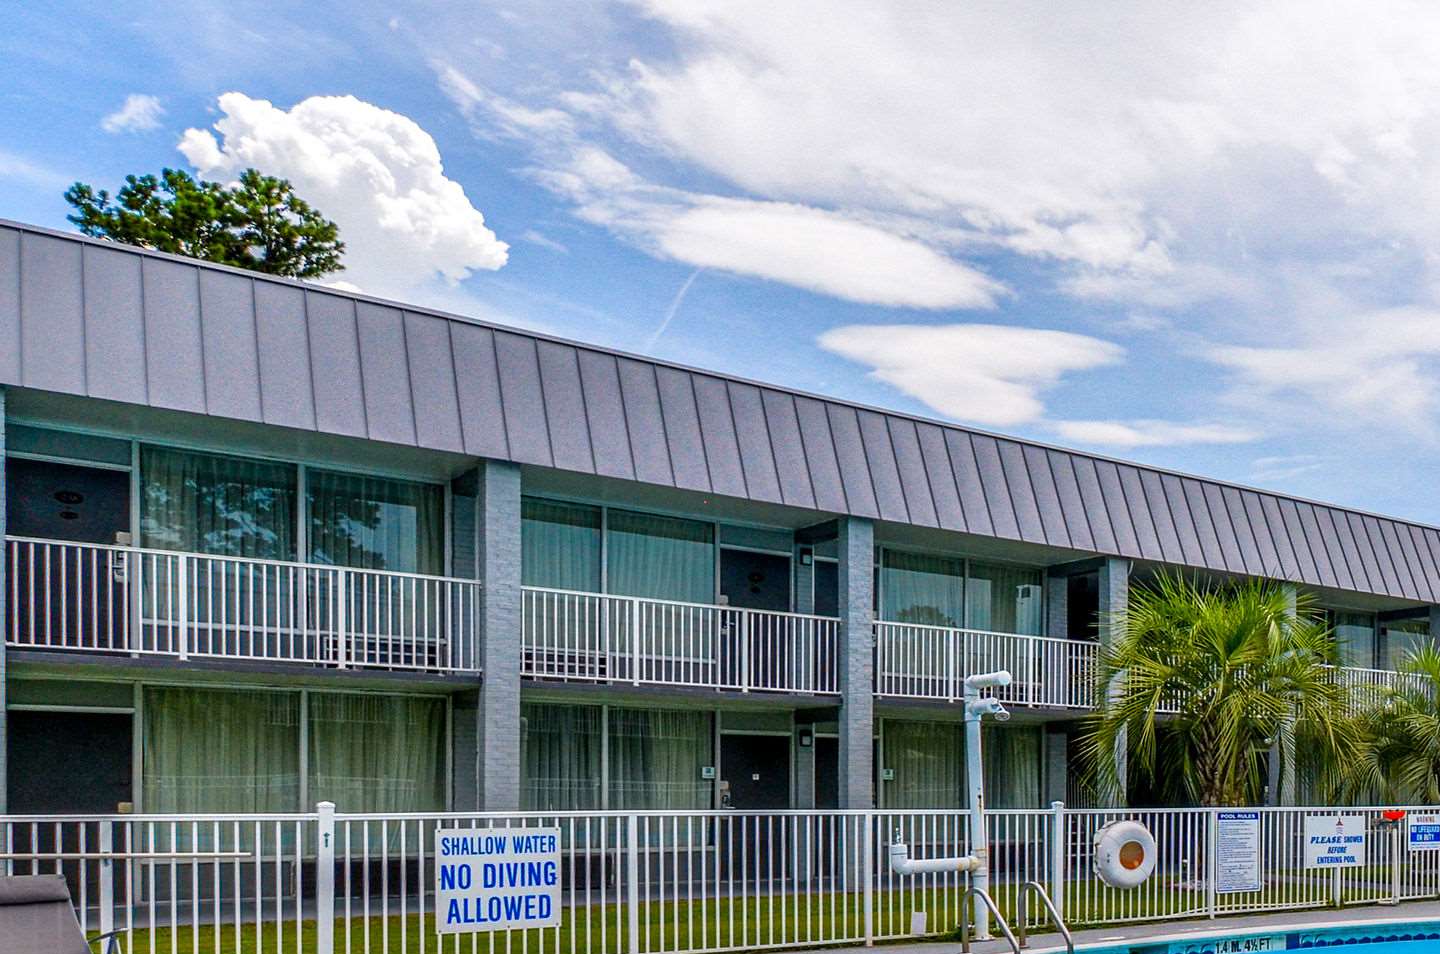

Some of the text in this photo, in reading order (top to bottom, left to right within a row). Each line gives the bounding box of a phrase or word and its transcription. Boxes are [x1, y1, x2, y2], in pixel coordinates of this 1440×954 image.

[441, 835, 556, 856] SHALLOW WATER
[1311, 835, 1363, 844] PLEASE SHOWER
[1328, 846, 1347, 854] BEFORE
[1317, 856, 1342, 864] ENTERING
[440, 861, 557, 890] NO DIVING
[447, 894, 551, 924] ALLOWED
[1216, 941, 1228, 954] 1.4
